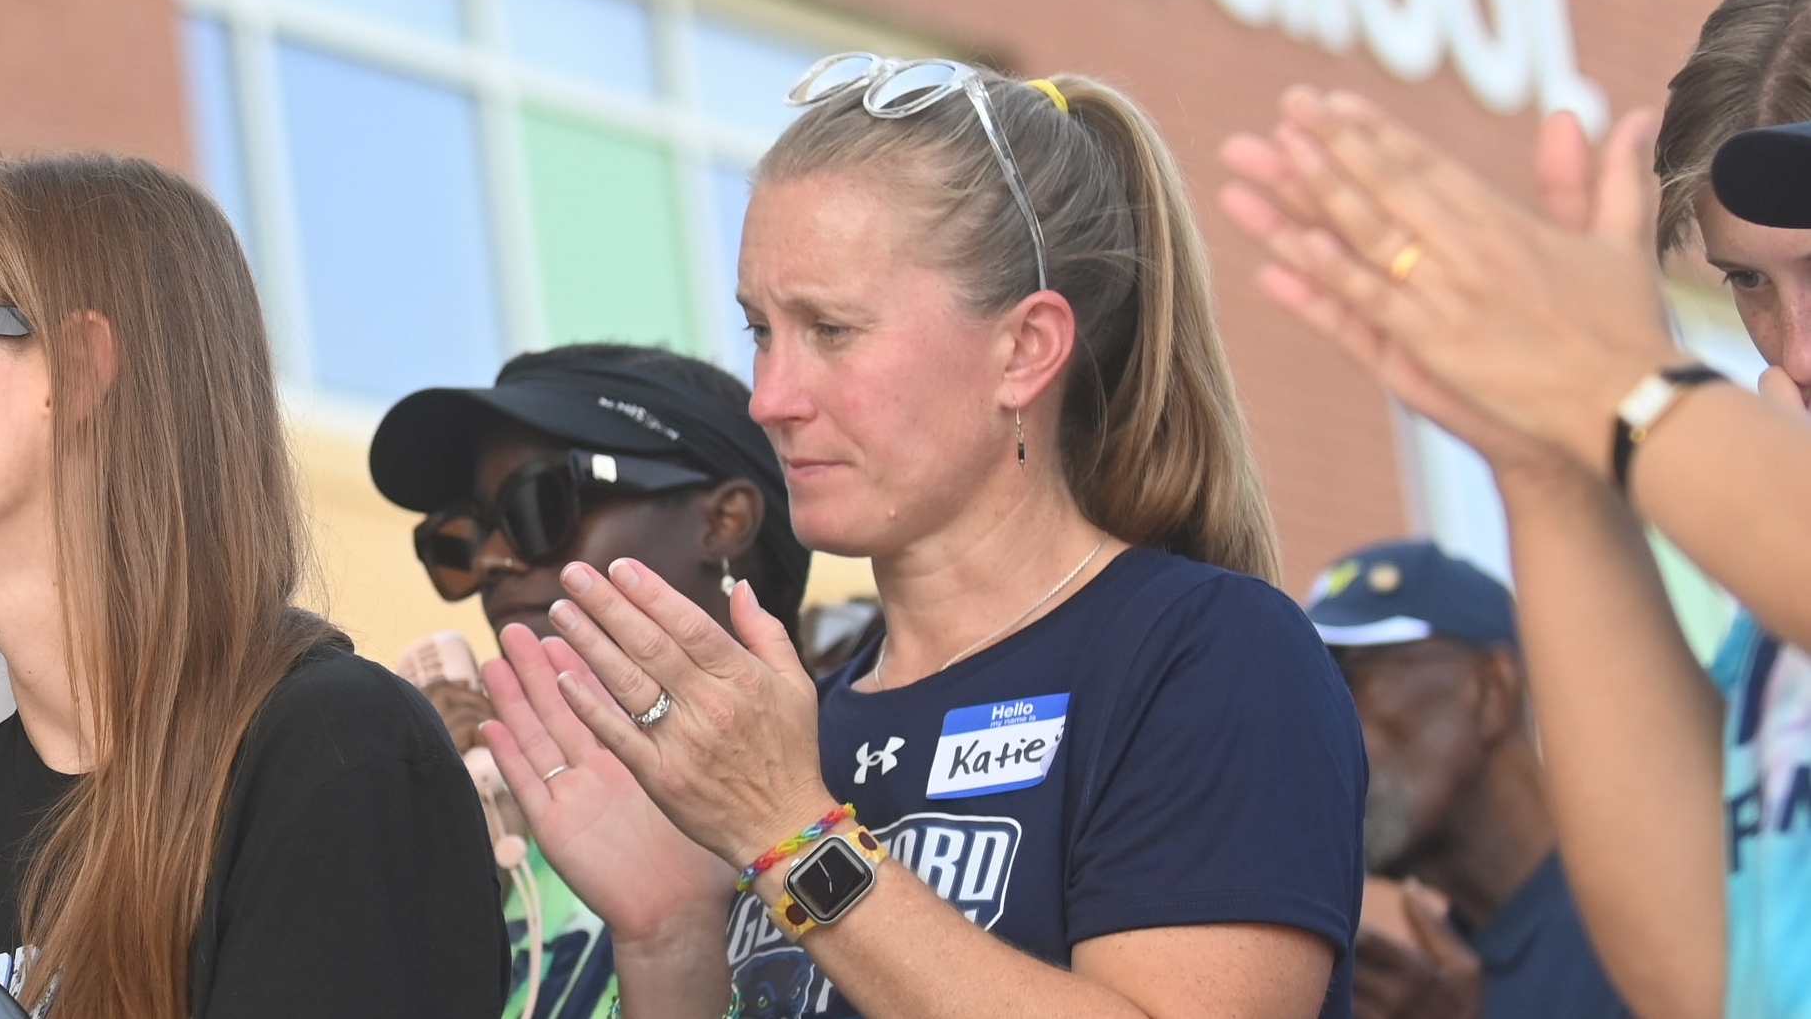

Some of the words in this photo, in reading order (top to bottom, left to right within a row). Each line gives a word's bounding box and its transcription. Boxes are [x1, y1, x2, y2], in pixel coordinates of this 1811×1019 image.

[991, 701, 1034, 720] Hello
[990, 720, 1003, 729] my
[1004, 715, 1027, 726] name
[1028, 714, 1037, 722] is
[948, 738, 1046, 780] Katie
